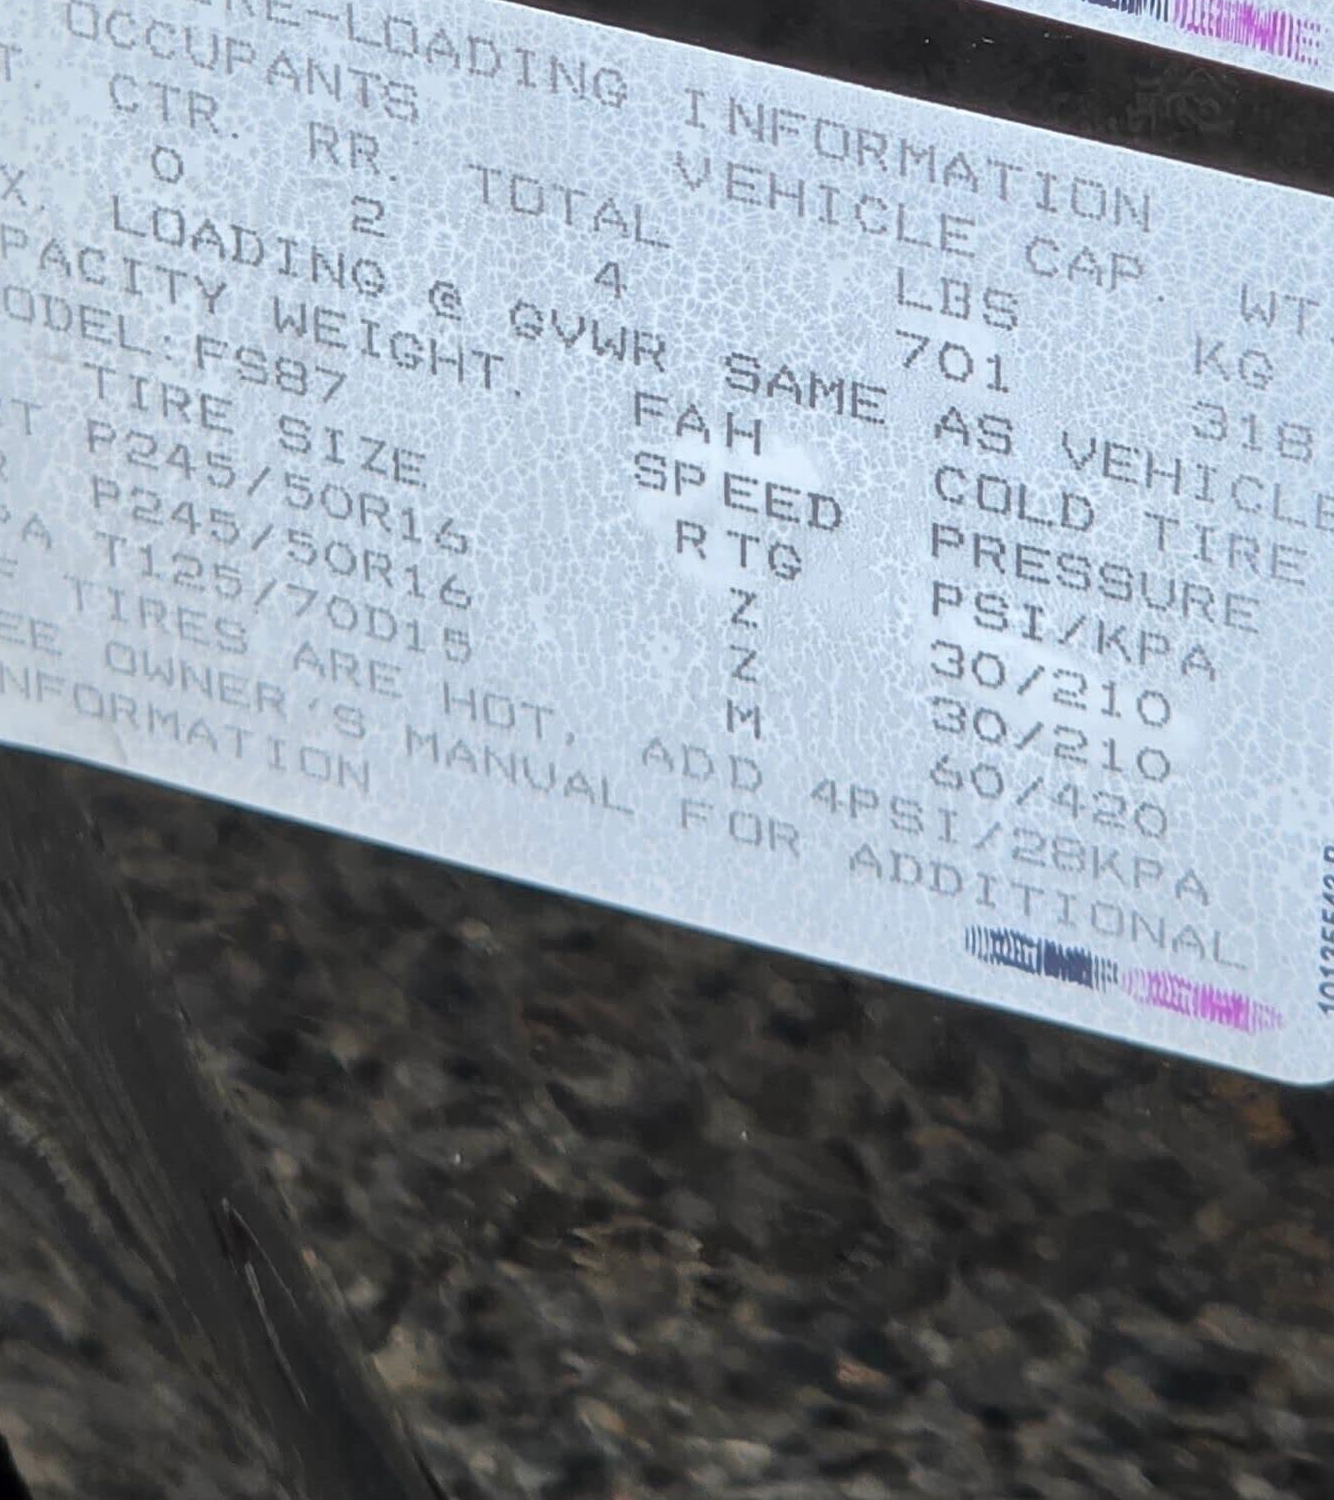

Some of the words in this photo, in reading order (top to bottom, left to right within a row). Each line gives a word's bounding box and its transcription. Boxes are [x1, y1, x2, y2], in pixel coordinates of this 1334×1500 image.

[105, 68, 241, 144] CTR.
[306, 119, 399, 183] RR.
[468, 160, 671, 251] TOTAL
[149, 141, 185, 189] 0
[349, 192, 387, 241] 2
[591, 253, 627, 303] 4
[673, 145, 978, 262] VEHICLE
[1024, 230, 1168, 307] CAP.
[683, 82, 1153, 239] INFORMATION
[110, 191, 386, 302] LOADING
[427, 274, 462, 323] @
[508, 295, 667, 375] GVWR
[723, 347, 888, 429] SAME
[932, 399, 1014, 458] AS
[273, 294, 524, 400] WEIGHT.
[894, 327, 1012, 396] 701
[1190, 397, 1315, 468] 318
[895, 265, 1020, 336] LBS
[1192, 334, 1277, 395] KG
[83, 358, 235, 438] TIRE
[277, 412, 429, 491] SIZE
[633, 386, 764, 460] FAH
[633, 445, 843, 537] SPEED
[85, 416, 469, 558] P245/50R16
[729, 584, 759, 633] Z
[930, 633, 1173, 736] 30/210
[675, 513, 805, 587] RTG
[930, 515, 1262, 640] PRESSURE
[933, 459, 1096, 541] COLD
[1142, 509, 1308, 590] TIRE
[90, 474, 472, 614] P245/50R16
[728, 642, 760, 686] Z
[929, 689, 1172, 791] 30/210
[95, 528, 473, 669] T125/70D15
[726, 700, 762, 742] M
[928, 745, 1170, 847] 60/420
[931, 575, 1218, 689] PSI/KPA
[62, 572, 249, 658] TIRES
[292, 636, 405, 703] ARE
[441, 678, 576, 752] HOT,
[641, 730, 762, 797] ADD
[808, 769, 1212, 912] 4PSI/28KPA
[103, 637, 367, 744] OWNER'S
[404, 720, 637, 818] MANUAL
[678, 793, 801, 859] FOR
[848, 836, 1250, 975] ADDITIONAL
